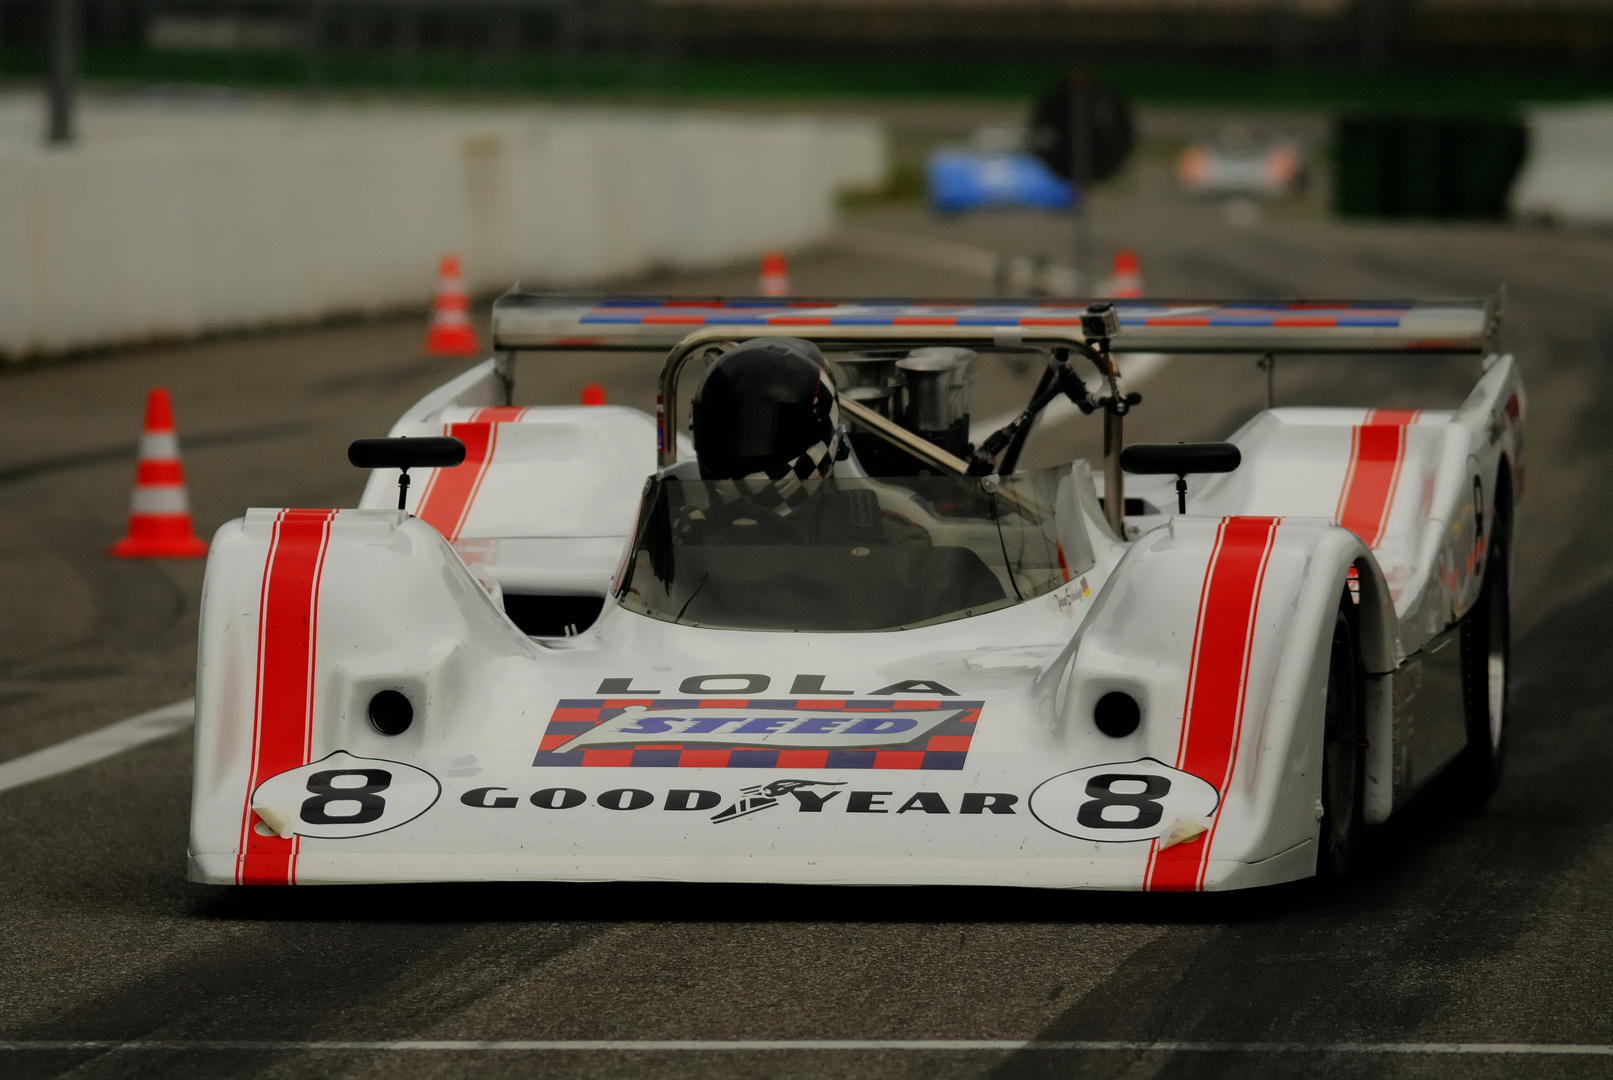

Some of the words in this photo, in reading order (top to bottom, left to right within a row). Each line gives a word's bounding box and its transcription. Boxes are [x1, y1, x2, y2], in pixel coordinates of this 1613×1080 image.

[596, 673, 961, 696] LOLA
[617, 717, 919, 734] STEED
[300, 768, 393, 824] 8
[1077, 773, 1171, 829] 8
